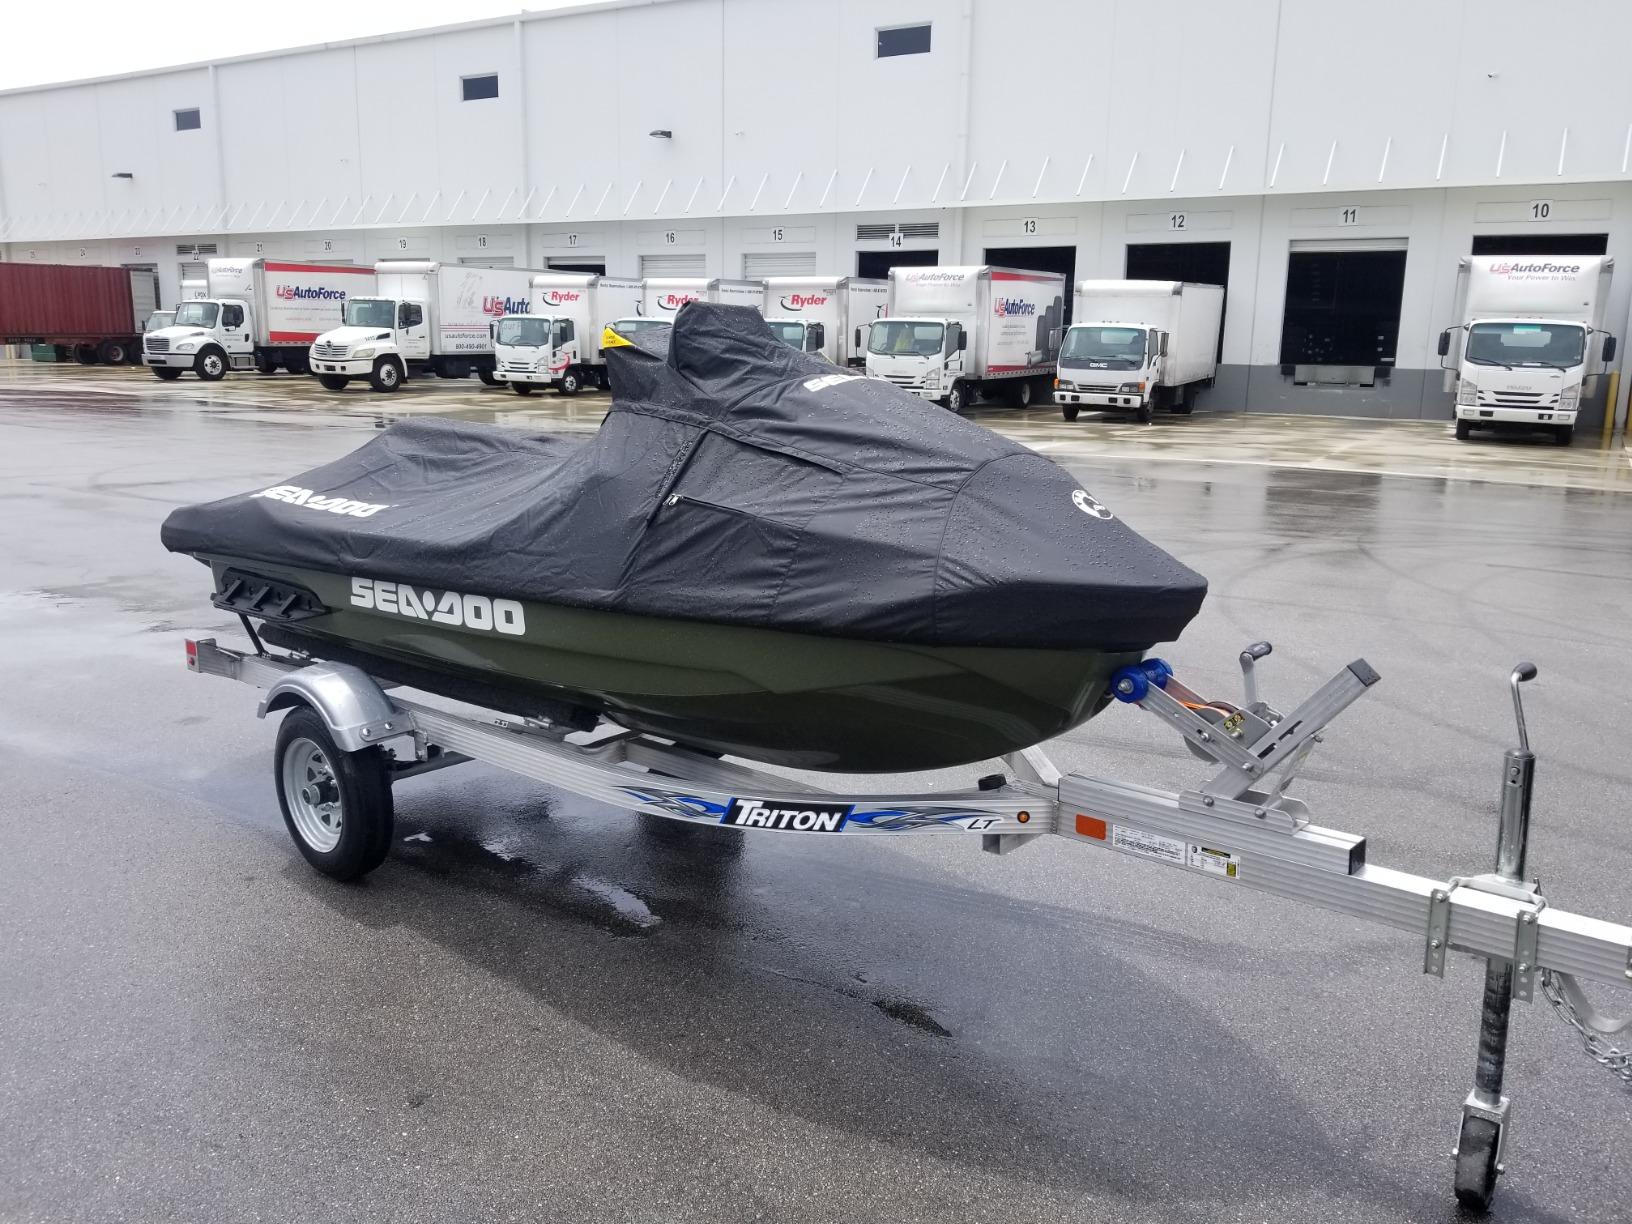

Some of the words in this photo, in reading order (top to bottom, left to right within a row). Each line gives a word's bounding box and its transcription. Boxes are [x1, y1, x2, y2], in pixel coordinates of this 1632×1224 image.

[1343, 208, 1357, 224] 11
[1532, 203, 1550, 218] 10
[1023, 220, 1036, 233] 13
[1171, 214, 1185, 229] 12
[479, 236, 487, 247] 18
[568, 234, 577, 245] 17
[665, 232, 675, 244] 16
[772, 229, 783, 241] 15
[890, 235, 902, 248] 14
[550, 290, 580, 304] Ryder
[790, 294, 827, 307] Ryder
[735, 799, 842, 831] TRITON
[966, 818, 997, 831] LT
